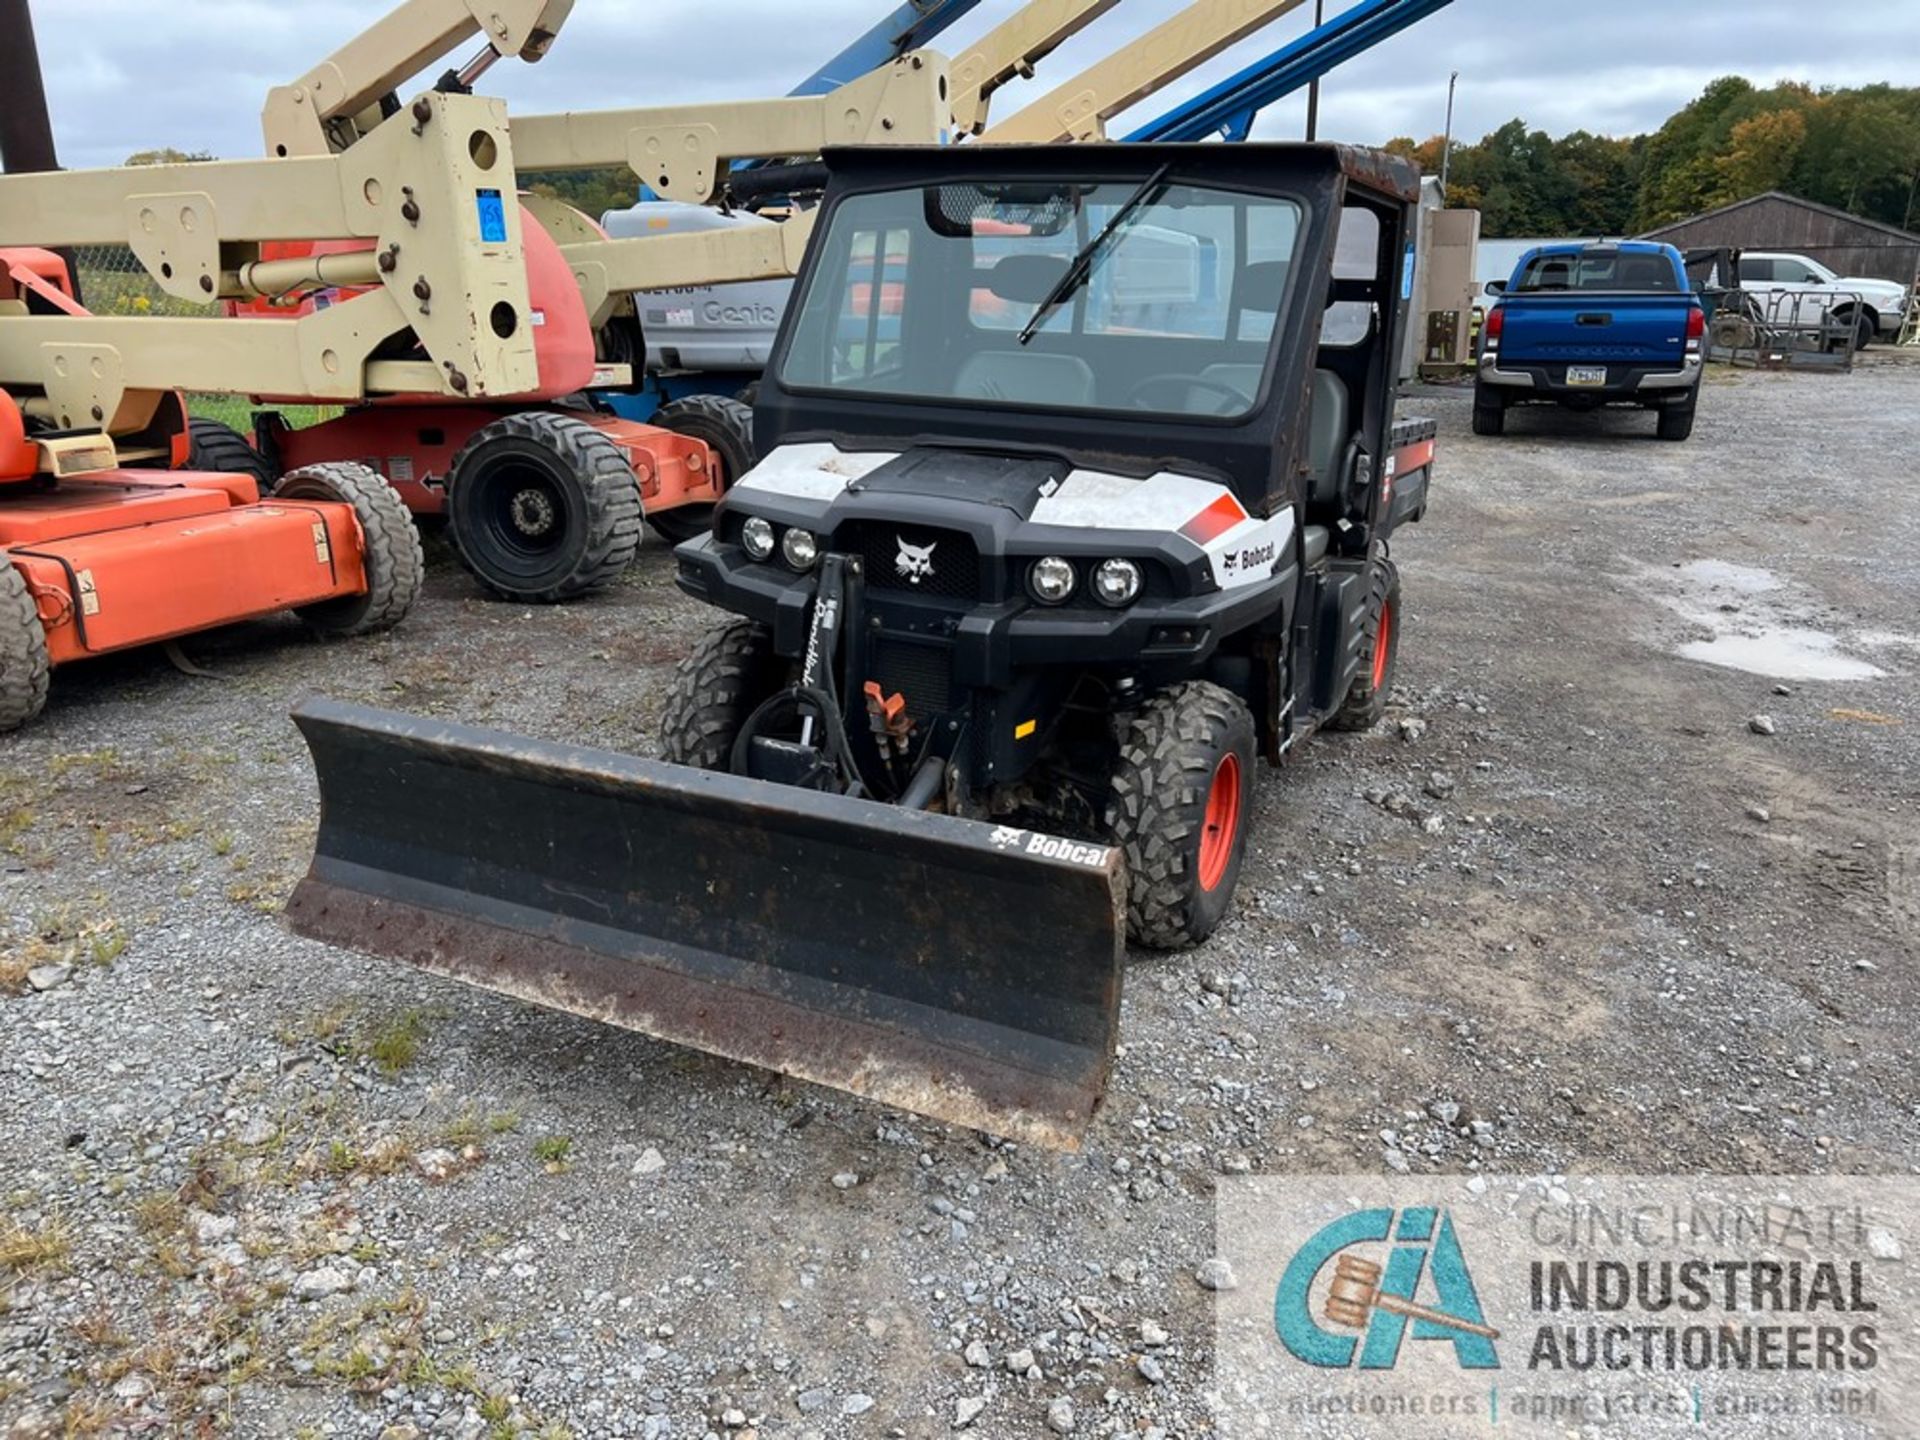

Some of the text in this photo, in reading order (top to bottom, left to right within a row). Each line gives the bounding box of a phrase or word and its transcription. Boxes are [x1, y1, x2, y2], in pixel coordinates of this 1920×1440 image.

[703, 301, 776, 324] Genie
[1241, 541, 1275, 571] Bobcat
[1025, 832, 1110, 867] Bobcat
